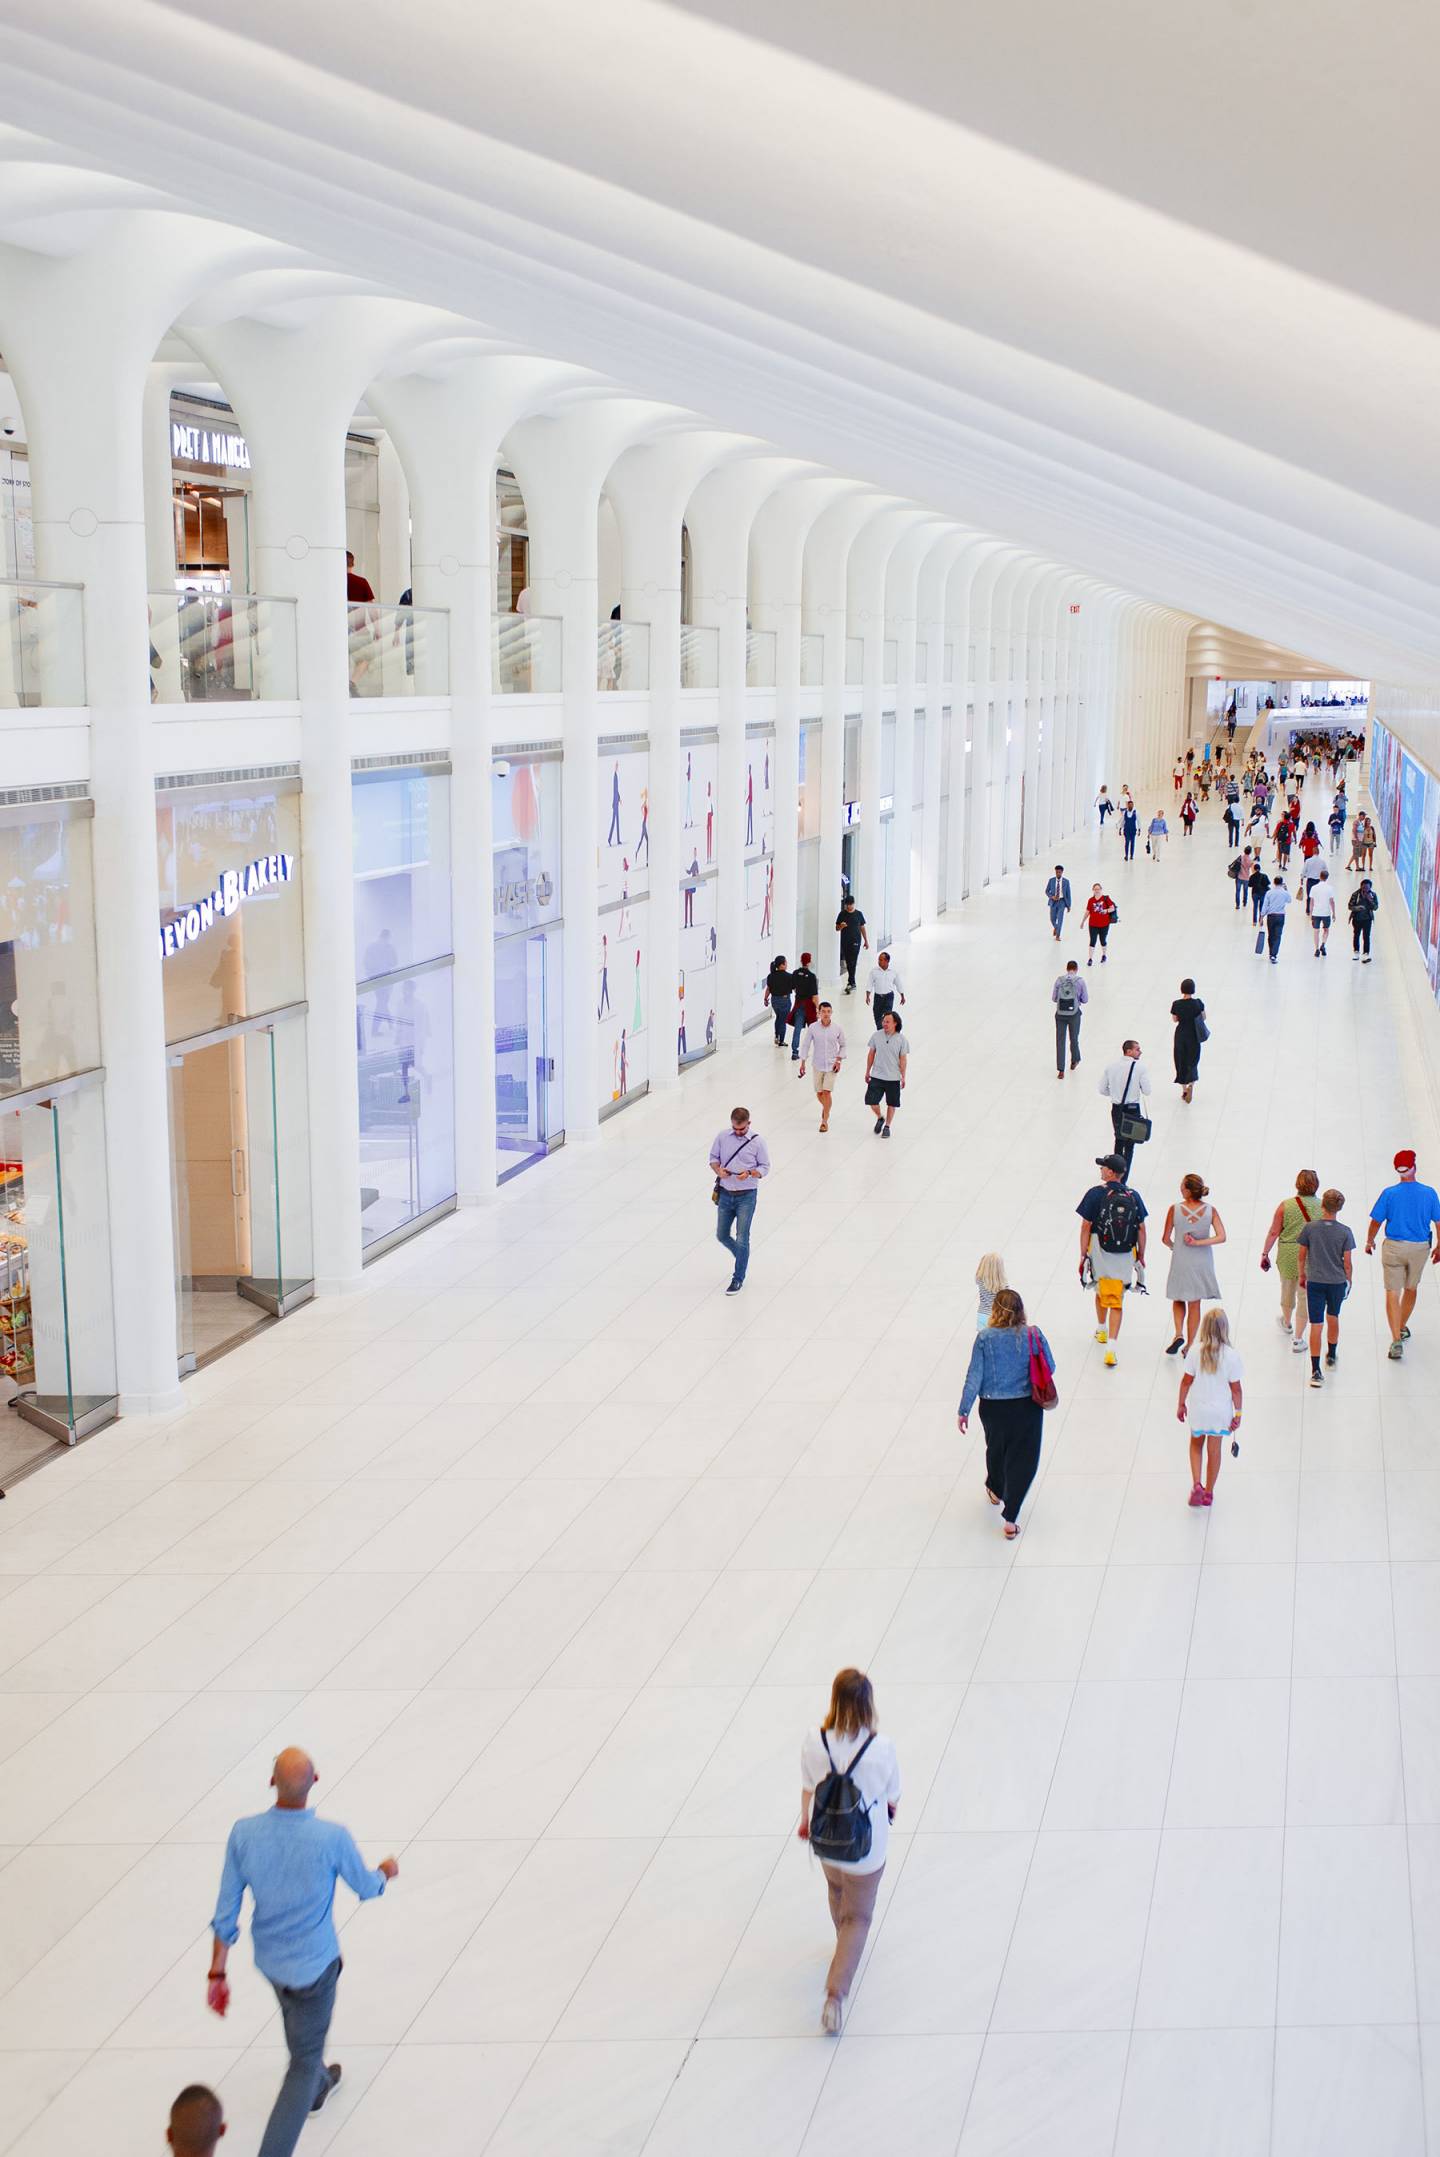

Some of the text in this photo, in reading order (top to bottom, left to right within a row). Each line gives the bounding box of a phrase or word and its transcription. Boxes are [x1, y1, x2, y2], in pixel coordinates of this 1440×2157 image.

[173, 423, 199, 460] PRET
[202, 431, 210, 463] A
[223, 853, 294, 917] BLAKELY
[494, 879, 536, 915] HASE
